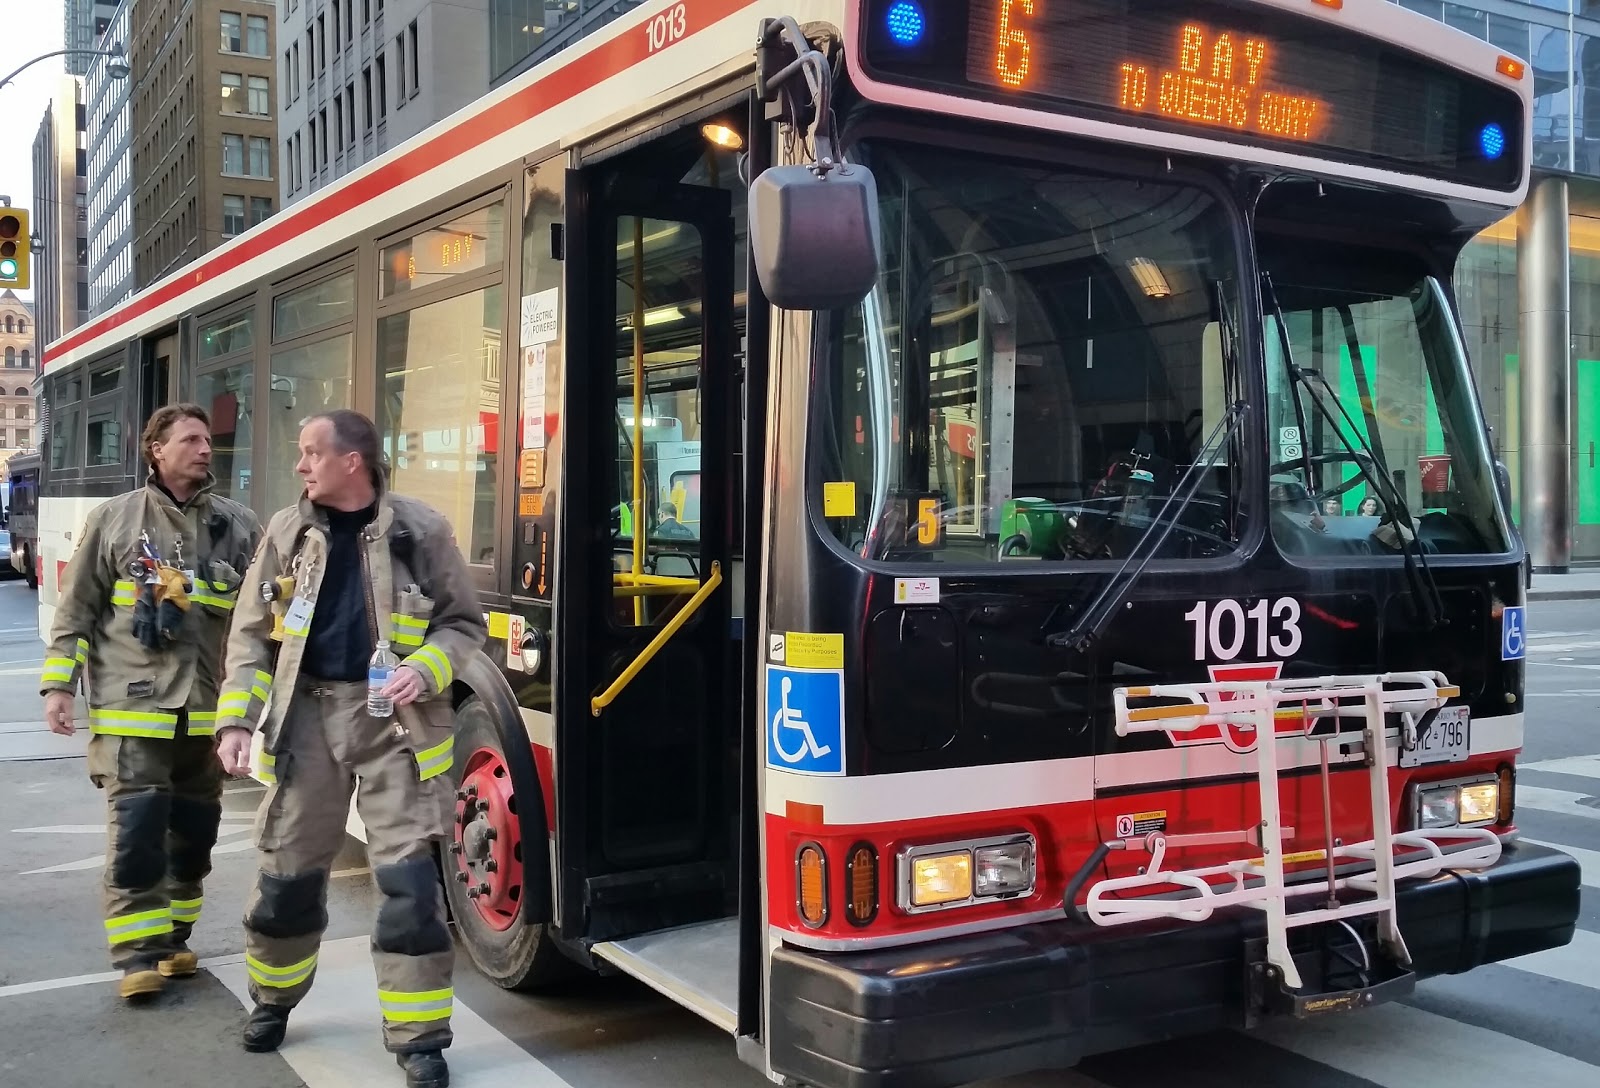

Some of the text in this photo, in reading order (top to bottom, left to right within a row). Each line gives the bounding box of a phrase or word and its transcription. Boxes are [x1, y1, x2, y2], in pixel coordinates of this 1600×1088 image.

[645, 3, 686, 52] 1013
[997, 0, 1034, 85] 6
[1181, 25, 1265, 85] BAY
[1122, 63, 1317, 138] TO QUEENS QUAY
[442, 233, 473, 267] BAY
[530, 309, 554, 324] ELECTRIC
[532, 320, 557, 335] POWERED
[918, 499, 936, 544] 5
[1184, 596, 1303, 661] 1013
[1440, 721, 1463, 748] 796
